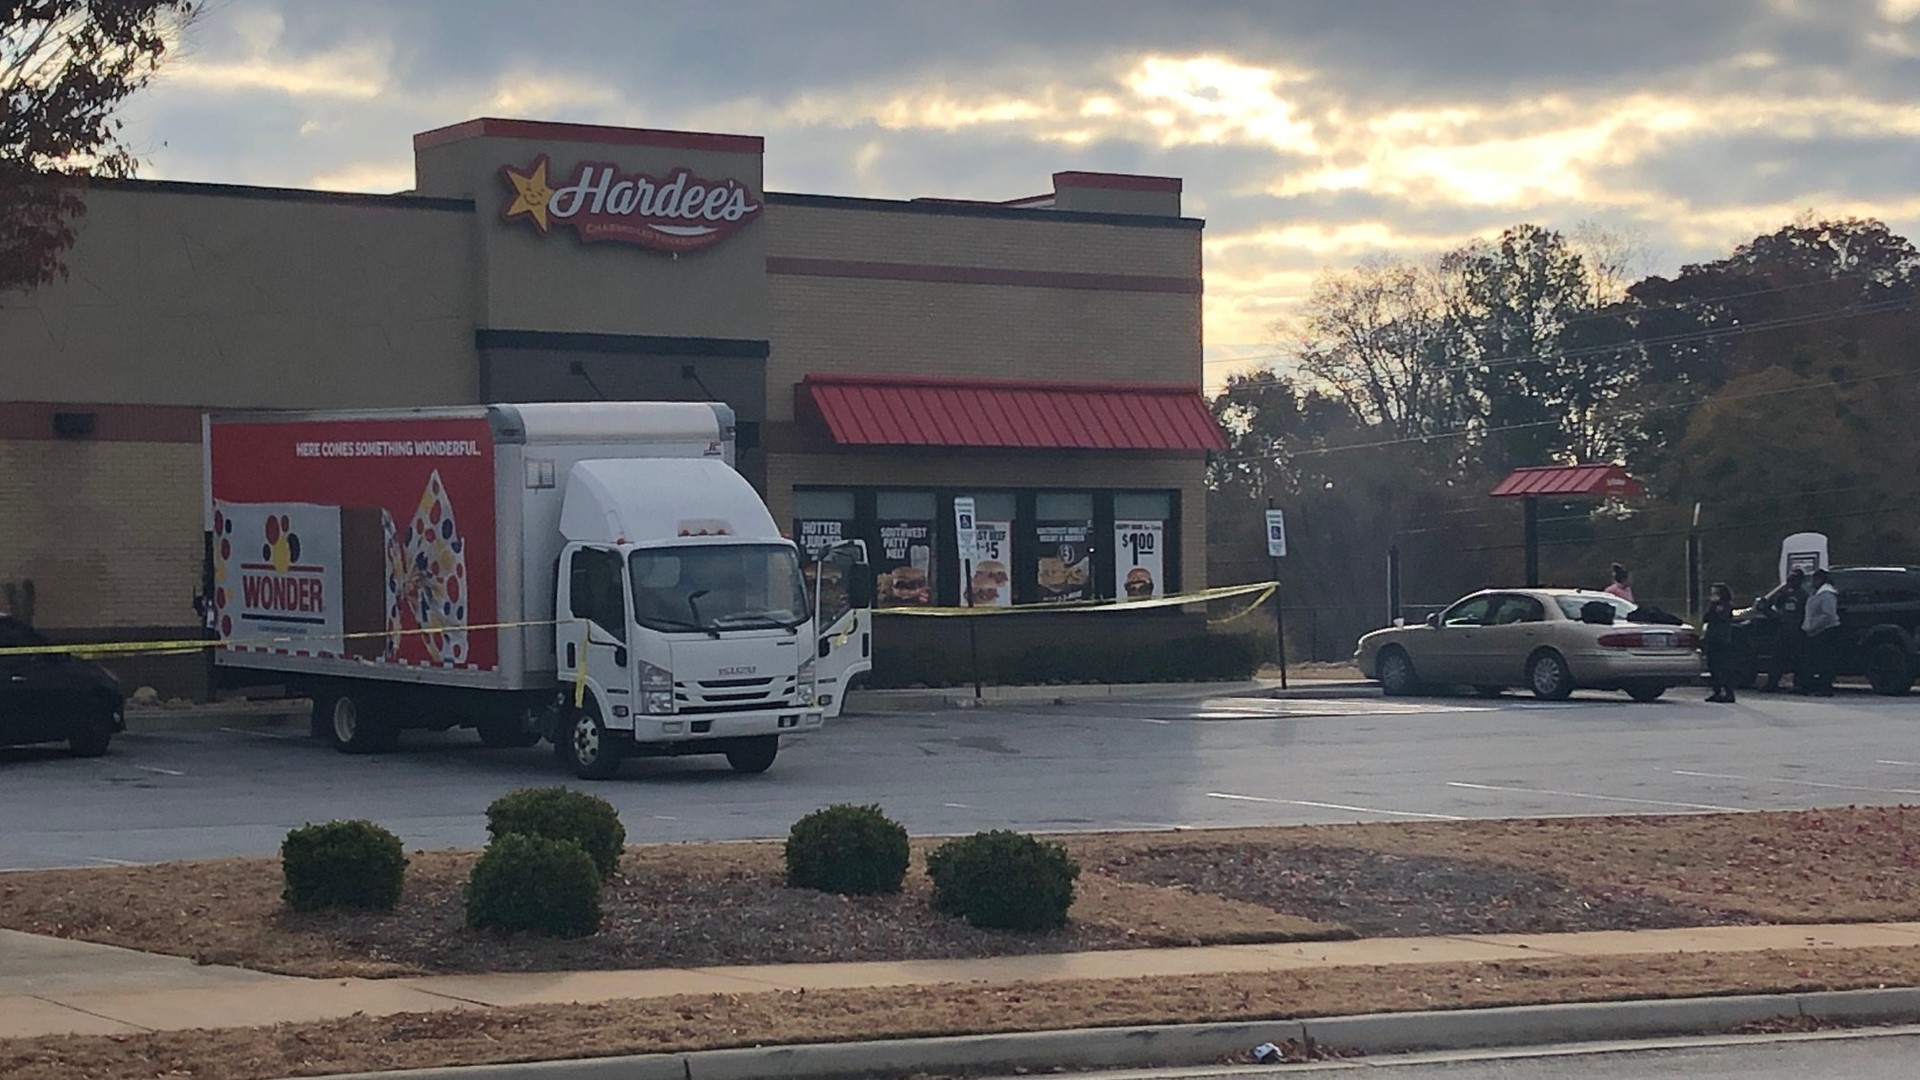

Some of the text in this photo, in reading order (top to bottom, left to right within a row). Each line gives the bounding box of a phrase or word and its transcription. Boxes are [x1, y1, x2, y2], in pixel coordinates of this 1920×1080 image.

[550, 166, 758, 221] Hardee's
[296, 440, 481, 457] HERE COMES SOMETHING WONDERFUL.
[802, 521, 842, 535] HOTTER
[880, 527, 927, 538] SOUTHWEST
[883, 537, 909, 548] PATTY
[886, 548, 906, 559] MELT
[243, 575, 322, 612] WONDER
